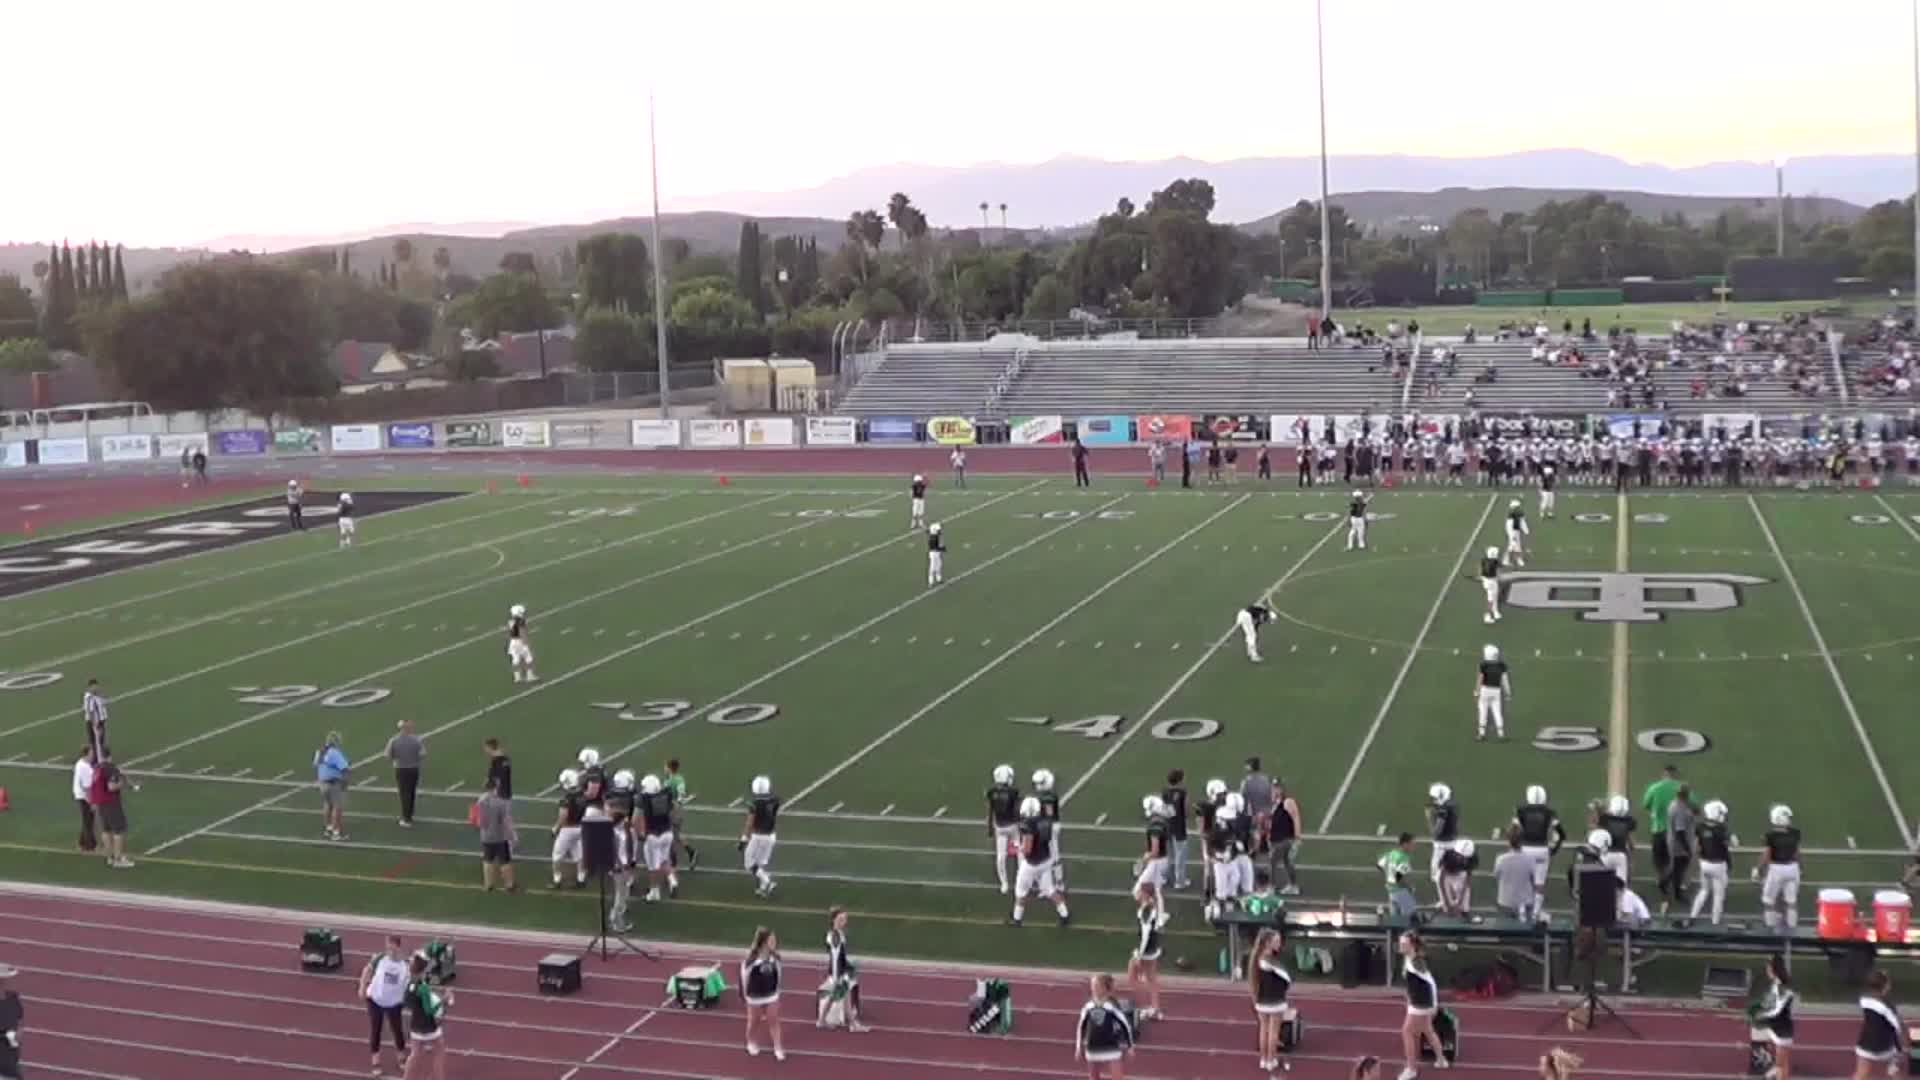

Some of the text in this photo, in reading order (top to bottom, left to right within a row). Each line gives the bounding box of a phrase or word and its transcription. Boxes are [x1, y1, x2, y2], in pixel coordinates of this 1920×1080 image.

[240, 685, 391, 707] 20
[617, 700, 779, 725] 30
[1052, 715, 1219, 740] 40
[1531, 726, 1706, 752] 50
